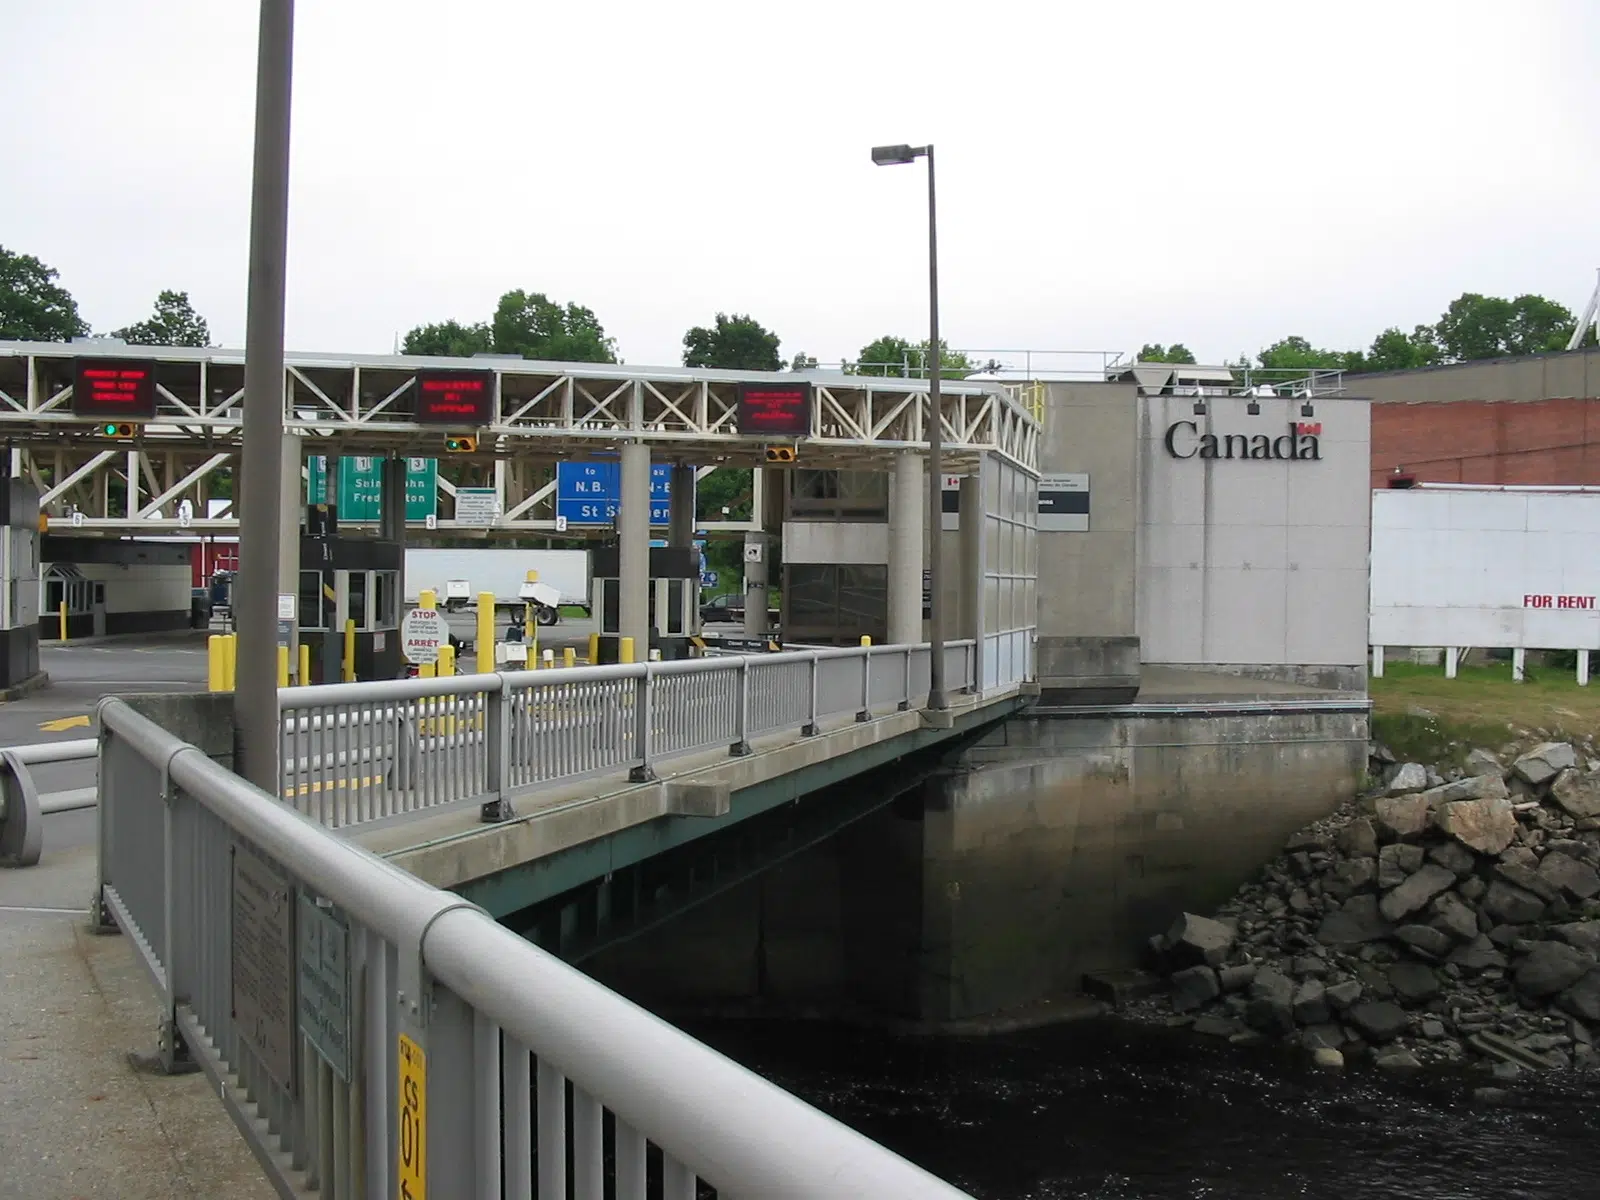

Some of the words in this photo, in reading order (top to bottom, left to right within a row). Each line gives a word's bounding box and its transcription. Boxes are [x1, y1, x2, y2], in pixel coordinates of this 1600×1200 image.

[1165, 420, 1323, 460] Canada
[585, 467, 596, 475] to
[653, 468, 665, 476] au
[355, 478, 382, 488] Sain
[581, 505, 598, 517] St
[427, 516, 434, 527] 3
[558, 519, 565, 529] 2
[1523, 594, 1553, 608] FOR
[1557, 595, 1597, 609] RENT
[412, 611, 436, 619] STOP
[408, 637, 439, 647] ARRÊT
